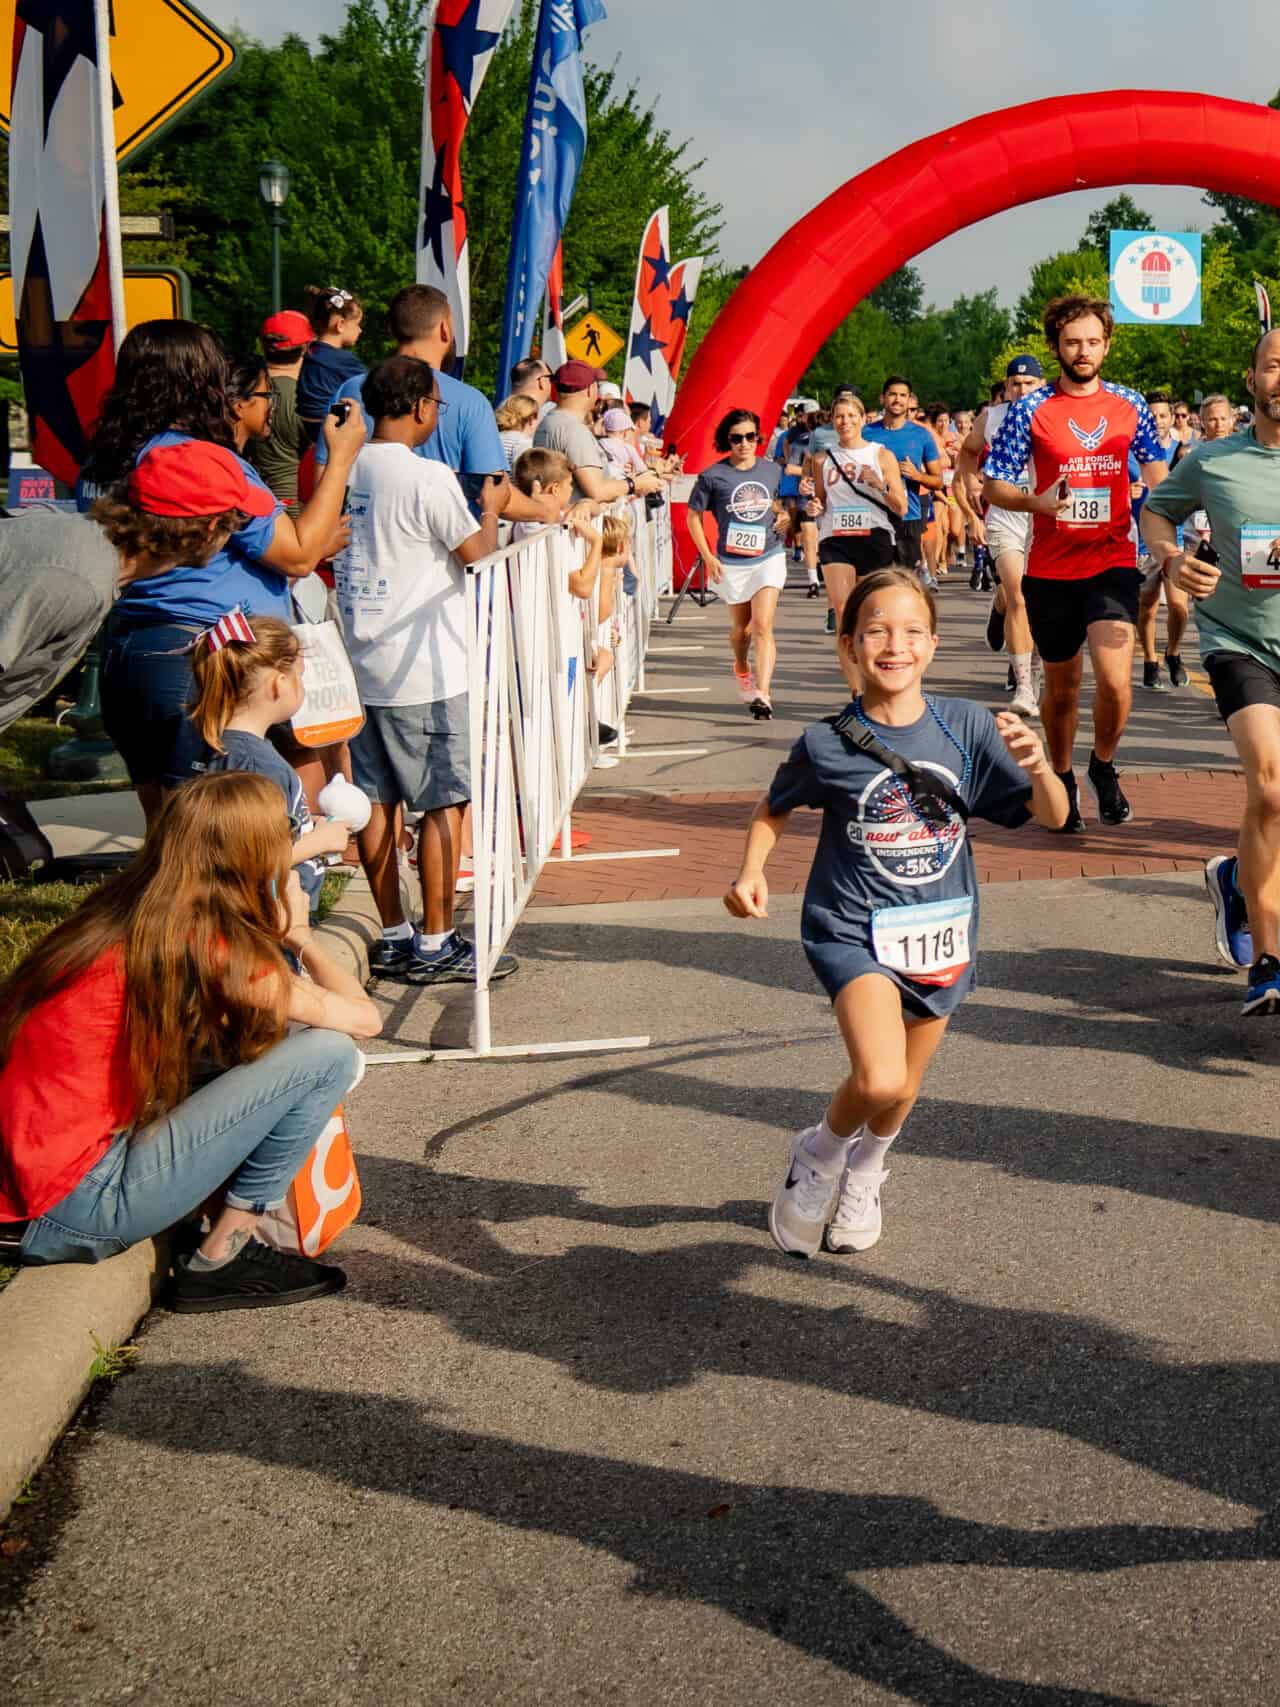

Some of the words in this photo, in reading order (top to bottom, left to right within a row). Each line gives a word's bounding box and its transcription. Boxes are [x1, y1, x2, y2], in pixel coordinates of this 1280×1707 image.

[1059, 460, 1121, 473] MARATHON
[1068, 456, 1083, 465] AIR
[1085, 454, 1114, 463] FORCE
[1072, 500, 1099, 519] 138
[840, 514, 862, 528] 584
[735, 532, 758, 548] 220
[865, 830, 902, 842] new
[906, 858, 933, 875] 5K
[897, 927, 954, 967] 1119
